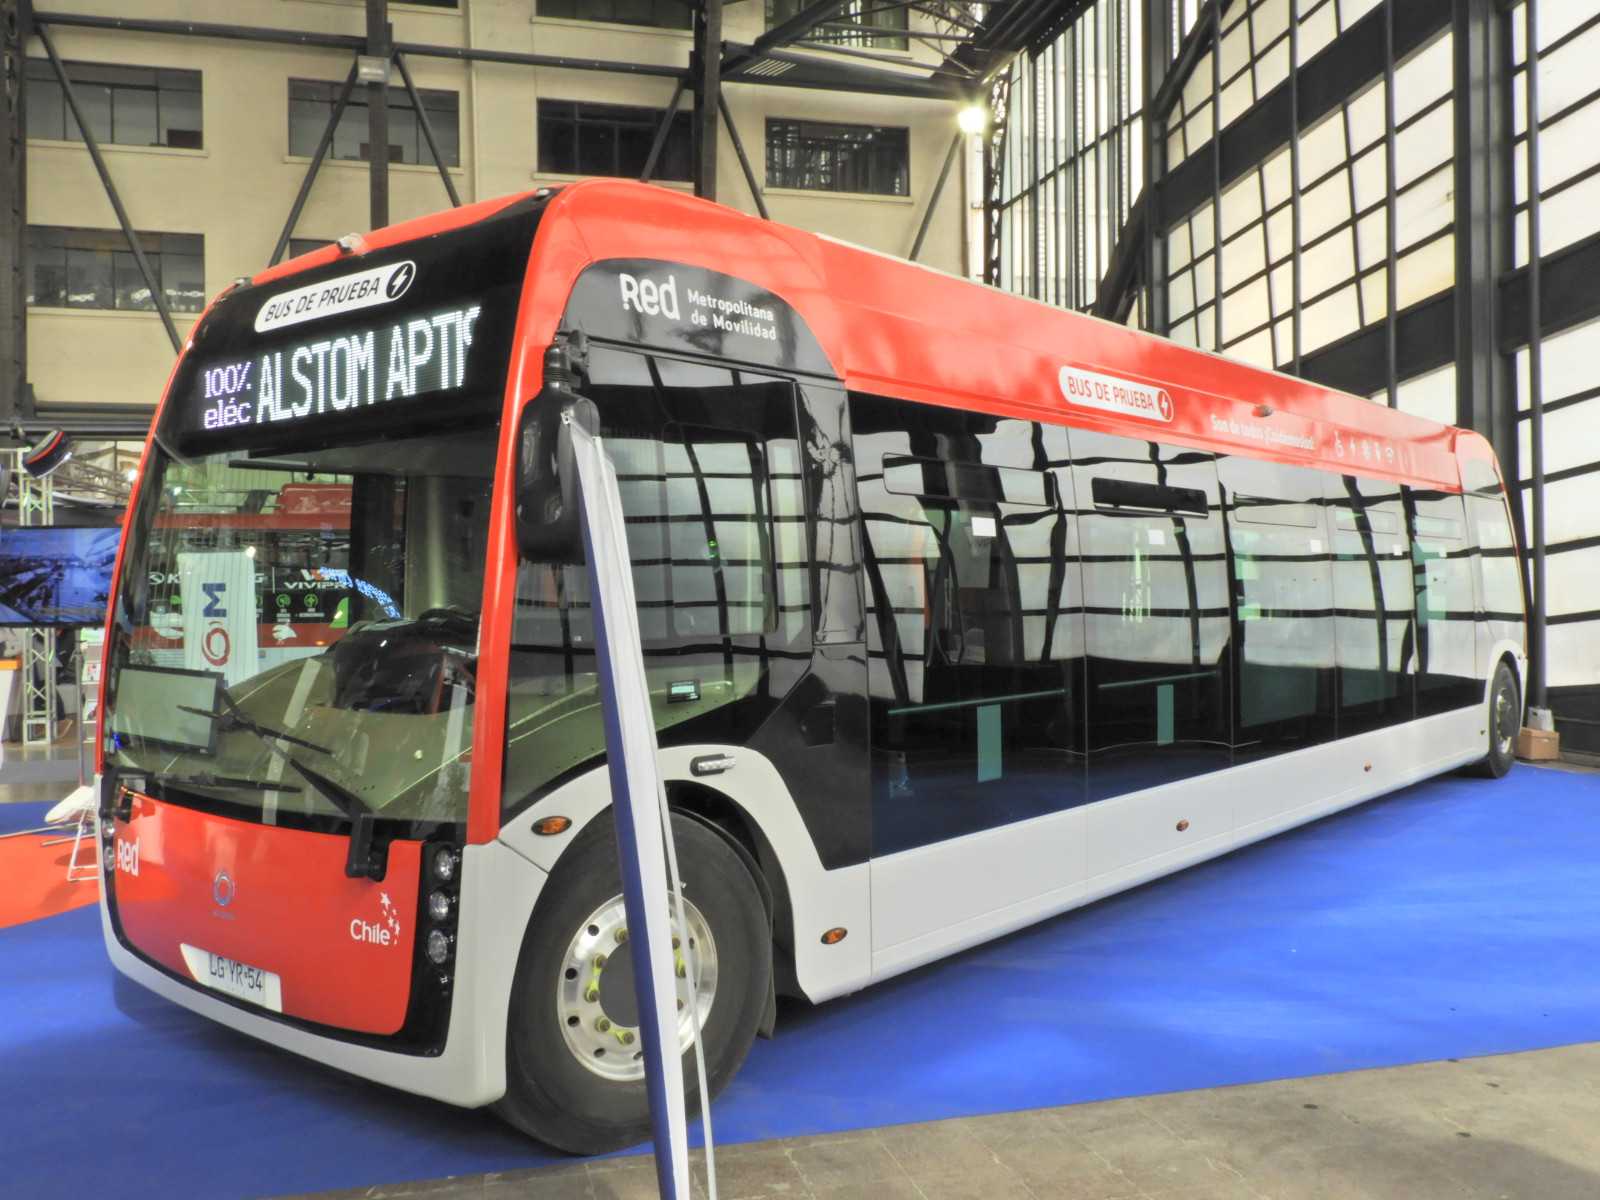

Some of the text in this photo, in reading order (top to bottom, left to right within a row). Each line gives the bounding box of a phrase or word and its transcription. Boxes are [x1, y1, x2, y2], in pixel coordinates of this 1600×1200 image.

[265, 277, 380, 323] BUS DE PRUEBA
[619, 273, 681, 320] Red
[687, 288, 774, 321] Metropolitana
[691, 310, 777, 340] de Movilidad
[204, 361, 252, 398] 100%
[256, 331, 374, 424] ALSTOM
[1068, 376, 1154, 409] BUS DE PRUEBA
[204, 397, 252, 429] eléc
[117, 836, 140, 877] Red
[350, 918, 391, 946] Chile
